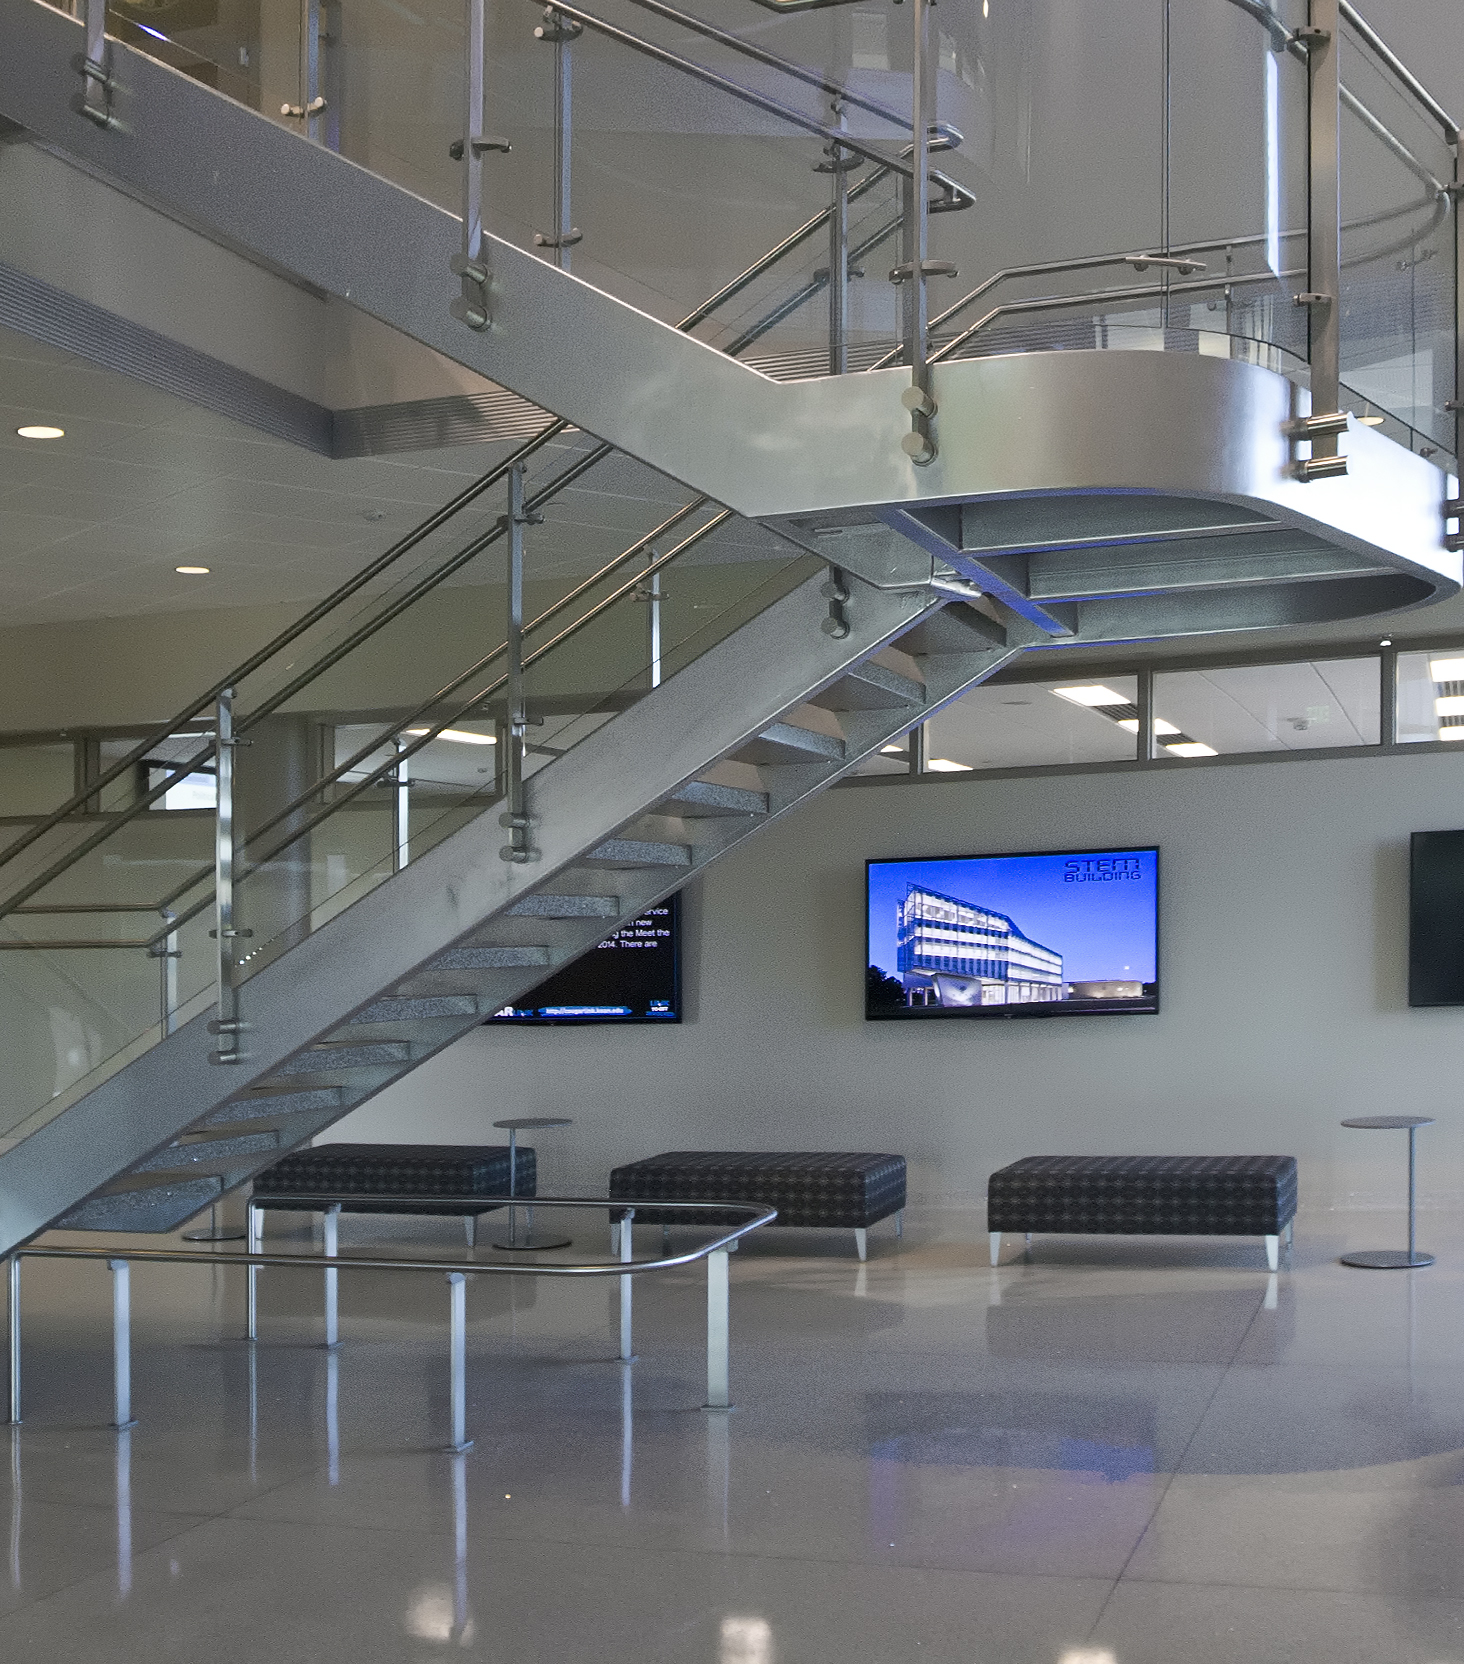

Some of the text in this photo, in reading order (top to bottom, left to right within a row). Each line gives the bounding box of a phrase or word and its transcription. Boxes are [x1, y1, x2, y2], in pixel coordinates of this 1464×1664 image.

[1064, 858, 1140, 873] STEM
[1064, 871, 1142, 883] BUILDING
[636, 929, 655, 937] Meet
[657, 928, 671, 937] the
[620, 940, 643, 948] There
[644, 940, 658, 948] are
